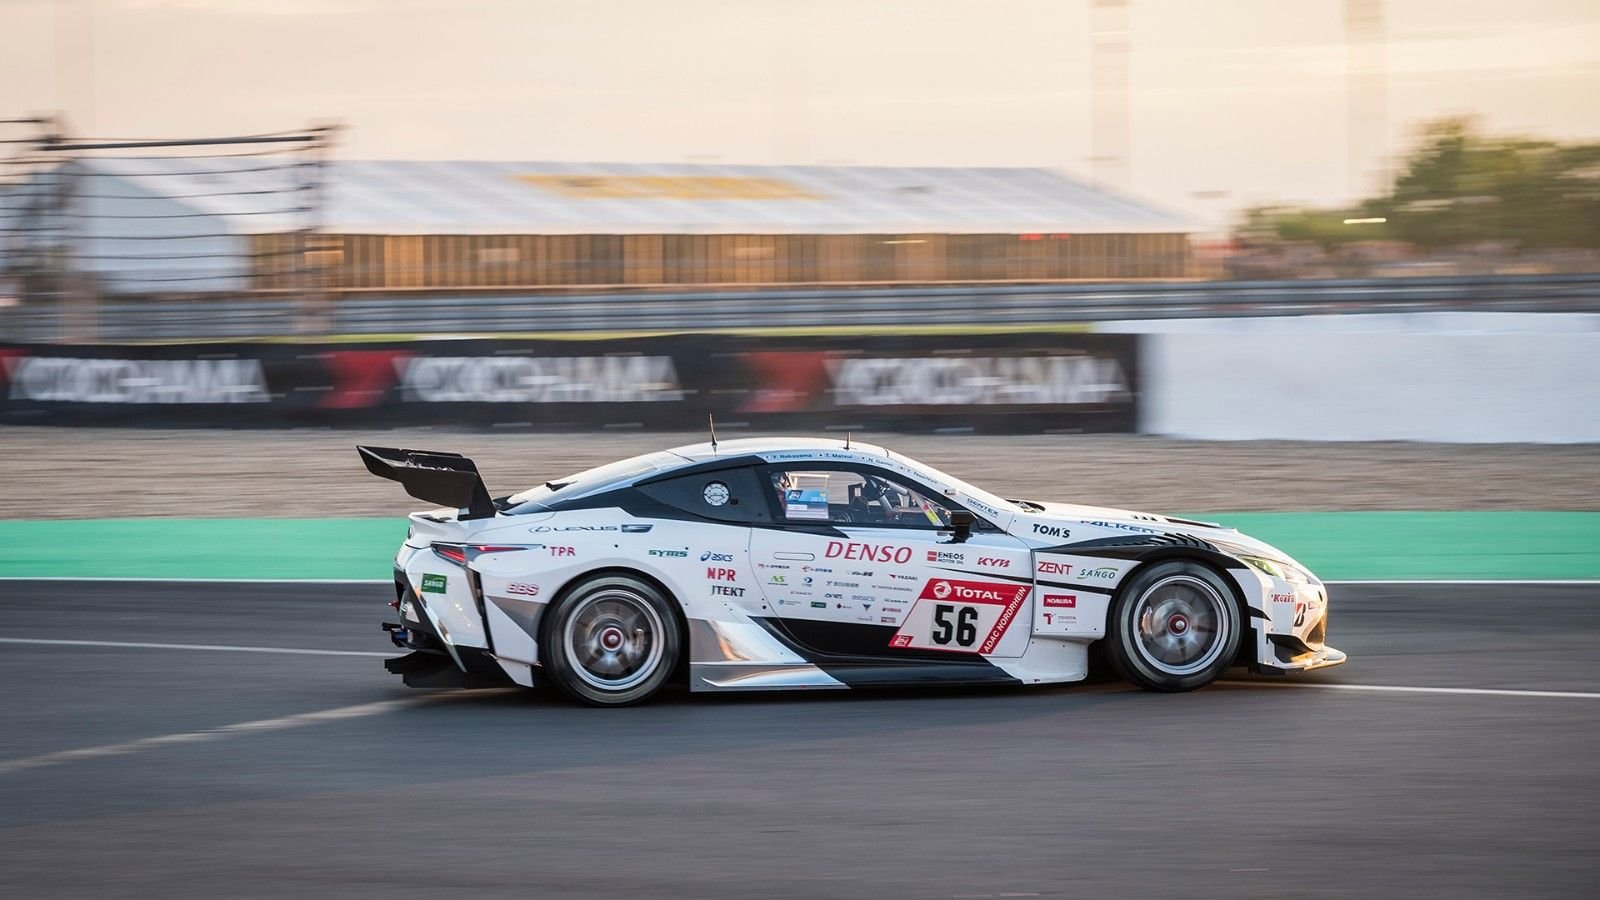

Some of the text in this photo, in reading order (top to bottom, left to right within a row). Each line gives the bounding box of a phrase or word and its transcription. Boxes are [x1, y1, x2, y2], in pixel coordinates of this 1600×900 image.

[549, 545, 576, 557] TPR
[711, 553, 733, 562] asics
[825, 541, 912, 564] DENSO
[938, 551, 965, 561] ENEOS
[977, 556, 1010, 568] KYB
[1037, 561, 1073, 576] ZENT
[706, 567, 736, 582] NPR
[1080, 568, 1116, 580] SANGO
[507, 583, 539, 596] BBS
[711, 585, 745, 597] JTEKT
[954, 586, 1003, 601] TOTAL
[932, 604, 979, 647] 56
[984, 587, 1026, 652] ADAC NORDRHEIN
